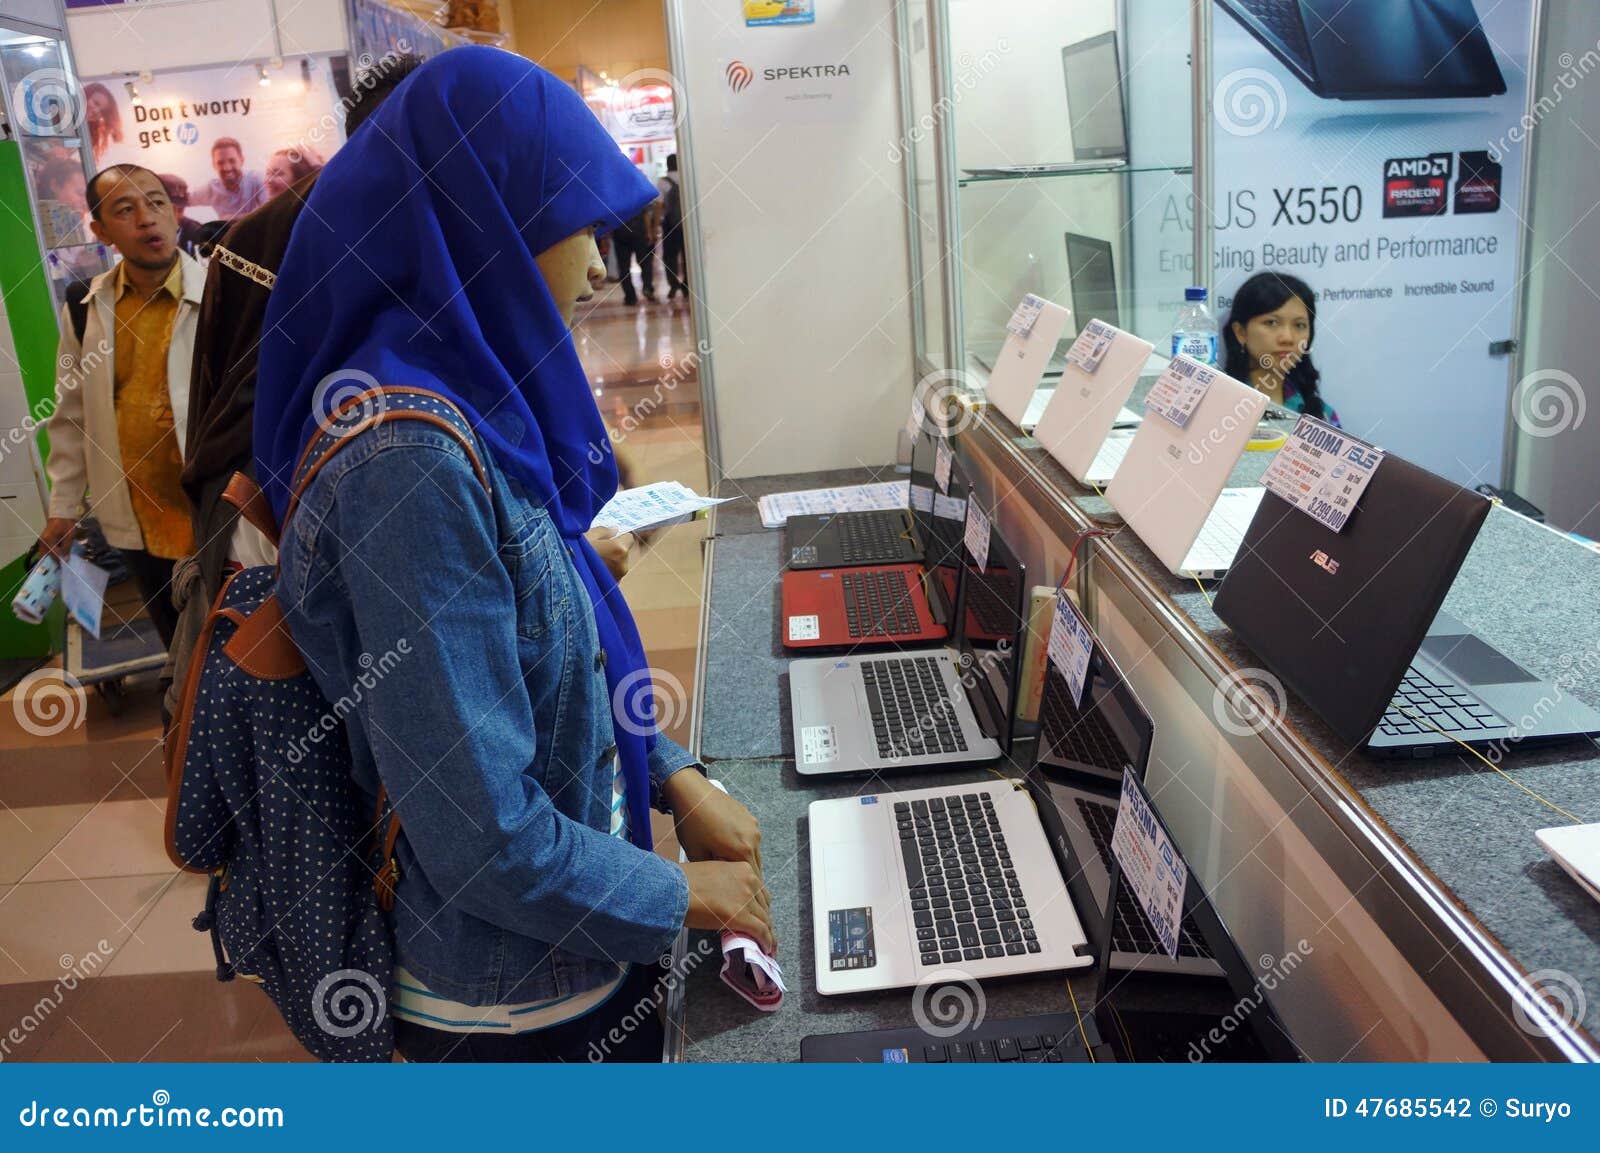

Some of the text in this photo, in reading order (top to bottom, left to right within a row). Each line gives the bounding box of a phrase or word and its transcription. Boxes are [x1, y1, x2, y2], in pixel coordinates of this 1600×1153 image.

[763, 64, 850, 81] SPEKTRA
[195, 97, 251, 116] worry
[139, 126, 171, 149] get
[1387, 160, 1431, 177] AMD
[1391, 187, 1441, 199] RADEON
[1272, 185, 1363, 226] X550
[1159, 235, 1498, 273] Enccling Beauty and Performance
[1323, 286, 1393, 301] Performance
[1404, 283, 1457, 297] Incredible
[1460, 279, 1495, 294] Sound
[1293, 420, 1378, 470] X200MA ASUS
[1307, 496, 1348, 530] 3.299.000
[1309, 549, 1340, 575] ASUS
[1158, 840, 1184, 887] ASUS
